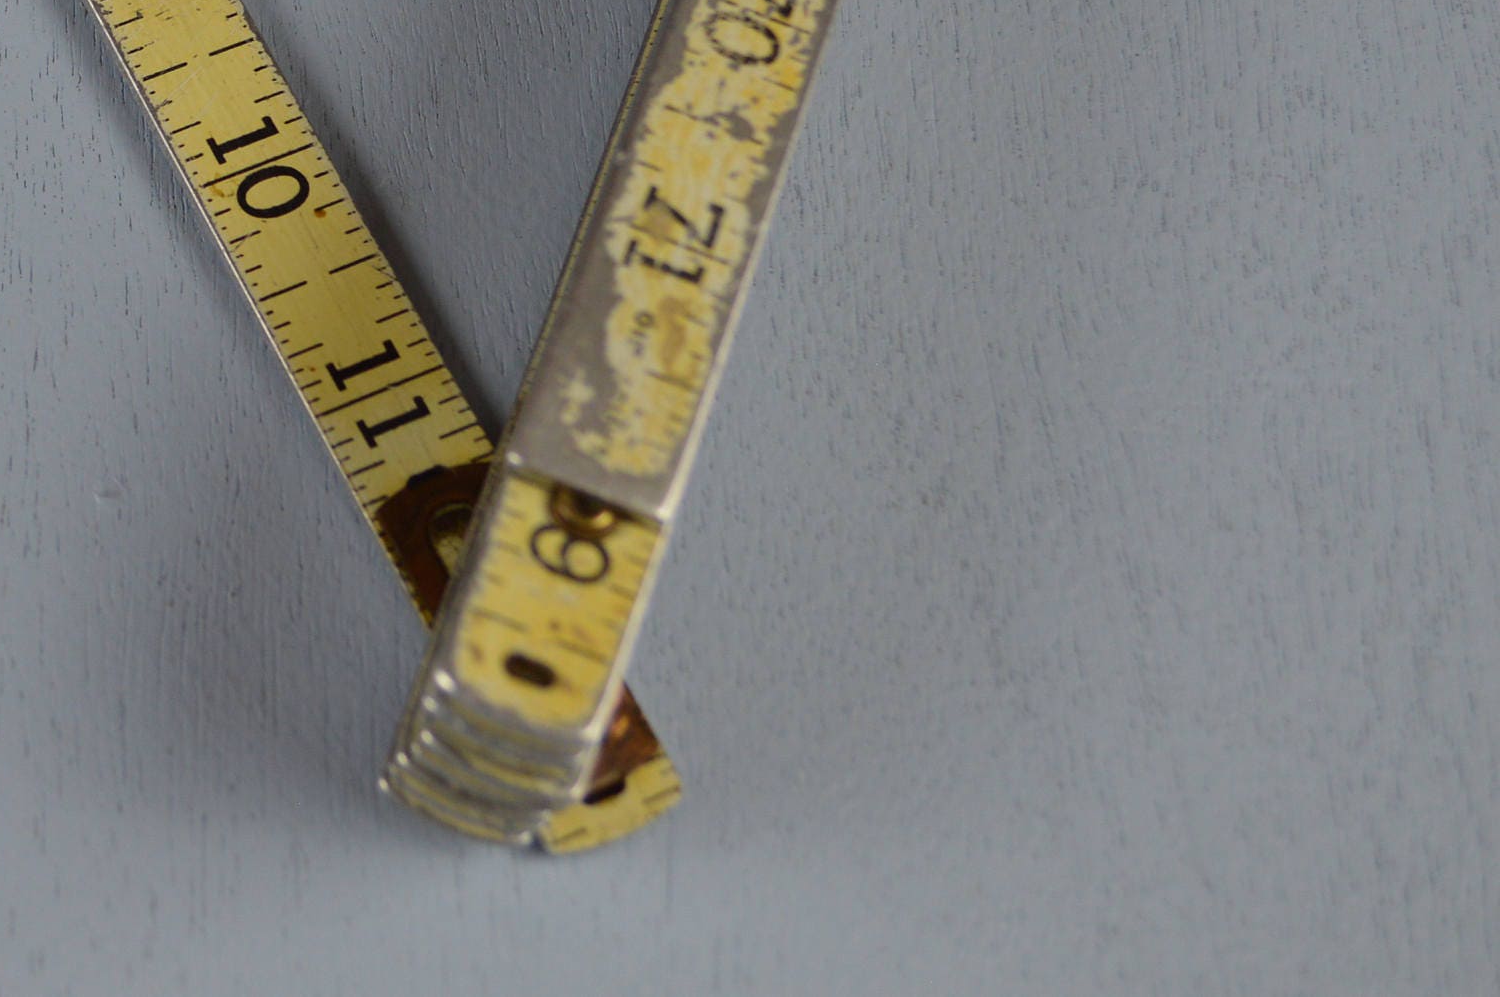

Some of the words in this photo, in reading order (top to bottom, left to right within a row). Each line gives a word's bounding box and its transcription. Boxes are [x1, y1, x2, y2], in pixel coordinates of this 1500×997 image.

[205, 115, 310, 219] 10
[623, 185, 725, 287] 71
[325, 339, 431, 448] 11
